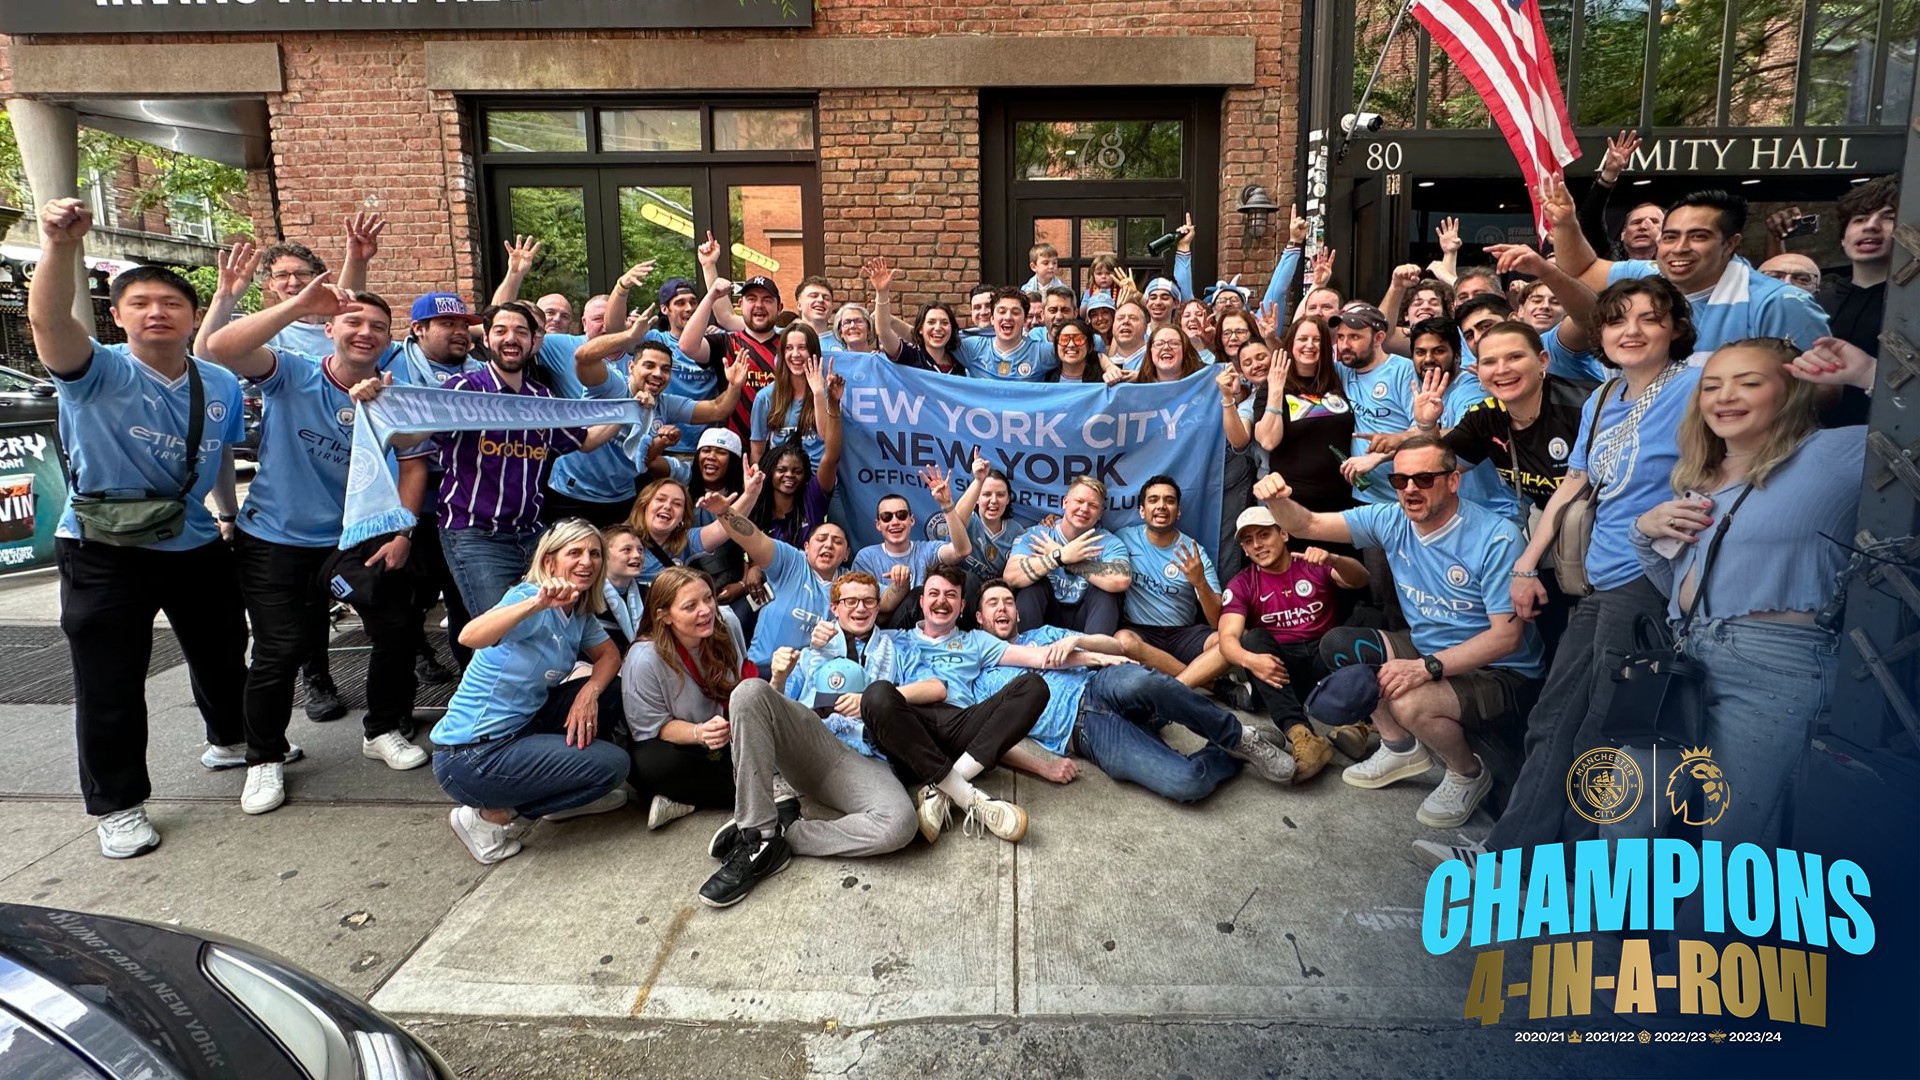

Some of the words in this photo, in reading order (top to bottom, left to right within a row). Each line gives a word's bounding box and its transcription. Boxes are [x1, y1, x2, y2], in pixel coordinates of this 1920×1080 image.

[1071, 132, 1126, 169] 78
[1366, 142, 1402, 170] 80
[1749, 137, 1858, 170] HALL
[437, 393, 514, 423] YORK
[515, 400, 561, 421] SKY
[851, 387, 926, 426] EW
[938, 400, 1068, 449] YORK
[1081, 403, 1188, 449] CITY
[876, 431, 982, 473] NEW
[995, 447, 1128, 487] YORK
[1131, 571, 1180, 595] TIHAD
[1399, 582, 1474, 611] TIHAD
[1260, 601, 1324, 624] ETIHAD
[1276, 614, 1316, 627] AIRWAYS
[100, 947, 156, 983] FARM
[149, 981, 193, 1018] NEW
[185, 1018, 225, 1068] YORK
